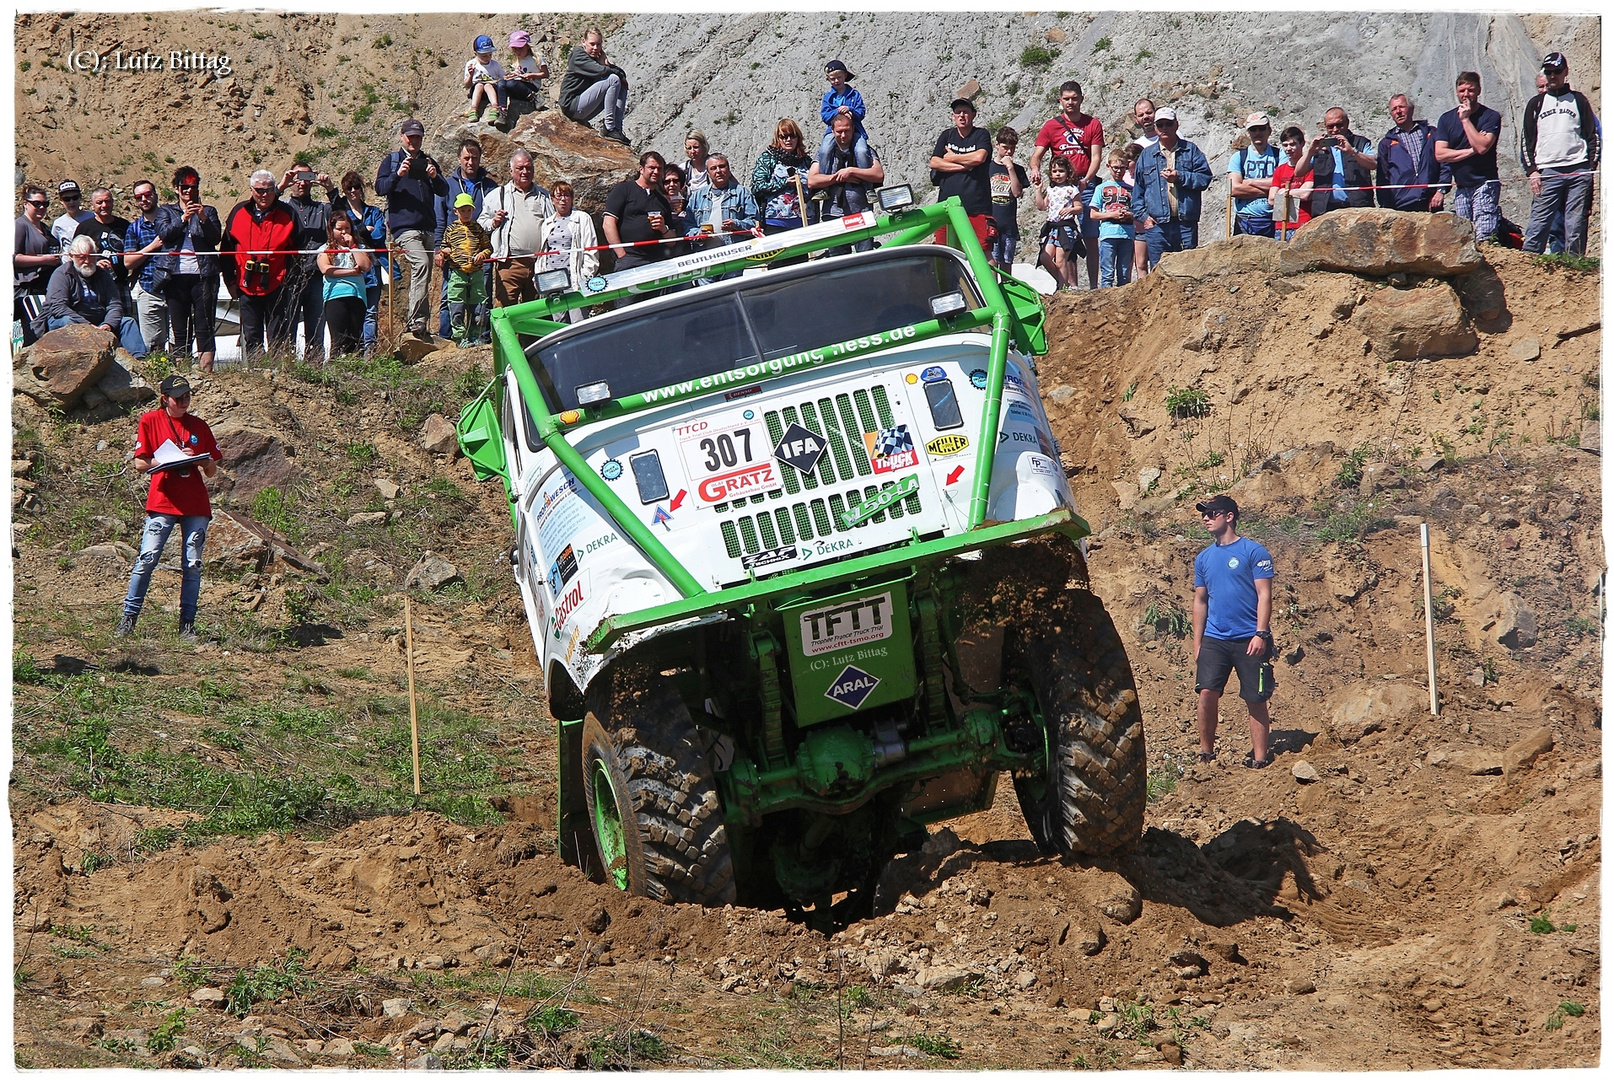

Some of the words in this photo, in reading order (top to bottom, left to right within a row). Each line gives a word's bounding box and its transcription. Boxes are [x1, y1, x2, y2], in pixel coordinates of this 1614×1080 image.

[677, 244, 753, 268] BEUTLHAUSER
[676, 421, 708, 436] TTCD
[1012, 431, 1038, 445] DEKRA
[699, 428, 753, 472] 307
[781, 437, 821, 460] IFA
[698, 463, 775, 502] GRÄTZ
[586, 532, 618, 554] DEKRA
[817, 538, 854, 556] DEKRA
[555, 580, 584, 631] Castrol
[803, 597, 885, 640] TFTT
[812, 632, 884, 653] www.cftt-tsmo.org
[834, 632, 853, 642] France
[853, 628, 870, 637] Truck
[871, 625, 884, 633] Trial
[833, 676, 874, 697] ARAL
